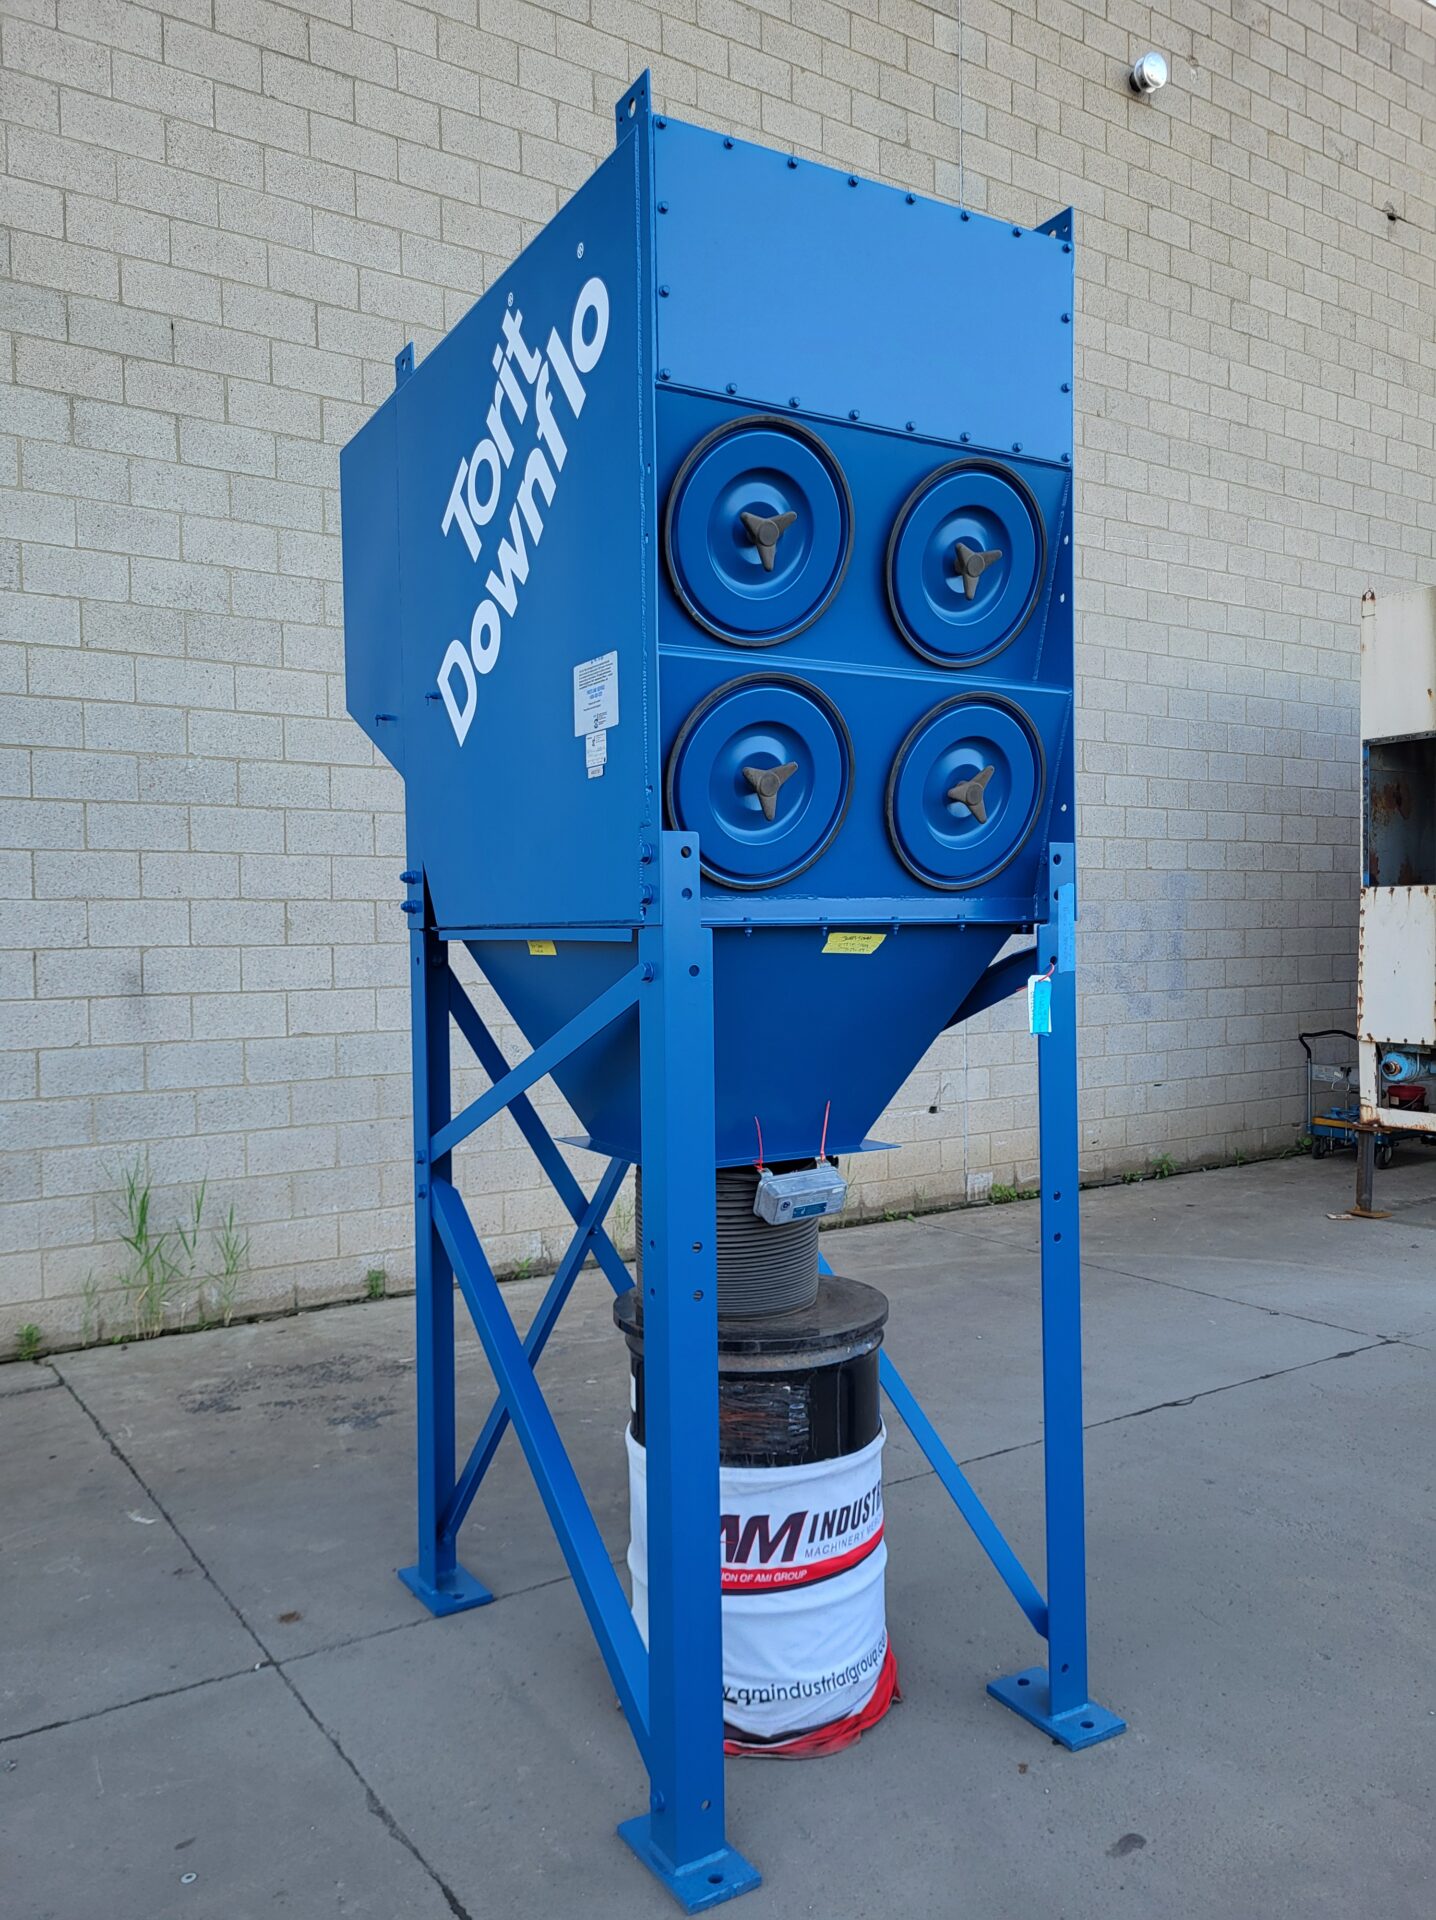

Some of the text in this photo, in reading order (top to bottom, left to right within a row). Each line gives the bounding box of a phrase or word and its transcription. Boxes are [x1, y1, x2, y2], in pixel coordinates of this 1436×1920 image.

[804, 1529, 866, 1559] MACHINERY
[739, 1572, 754, 1583] OF
[773, 1569, 808, 1583] GROUP
